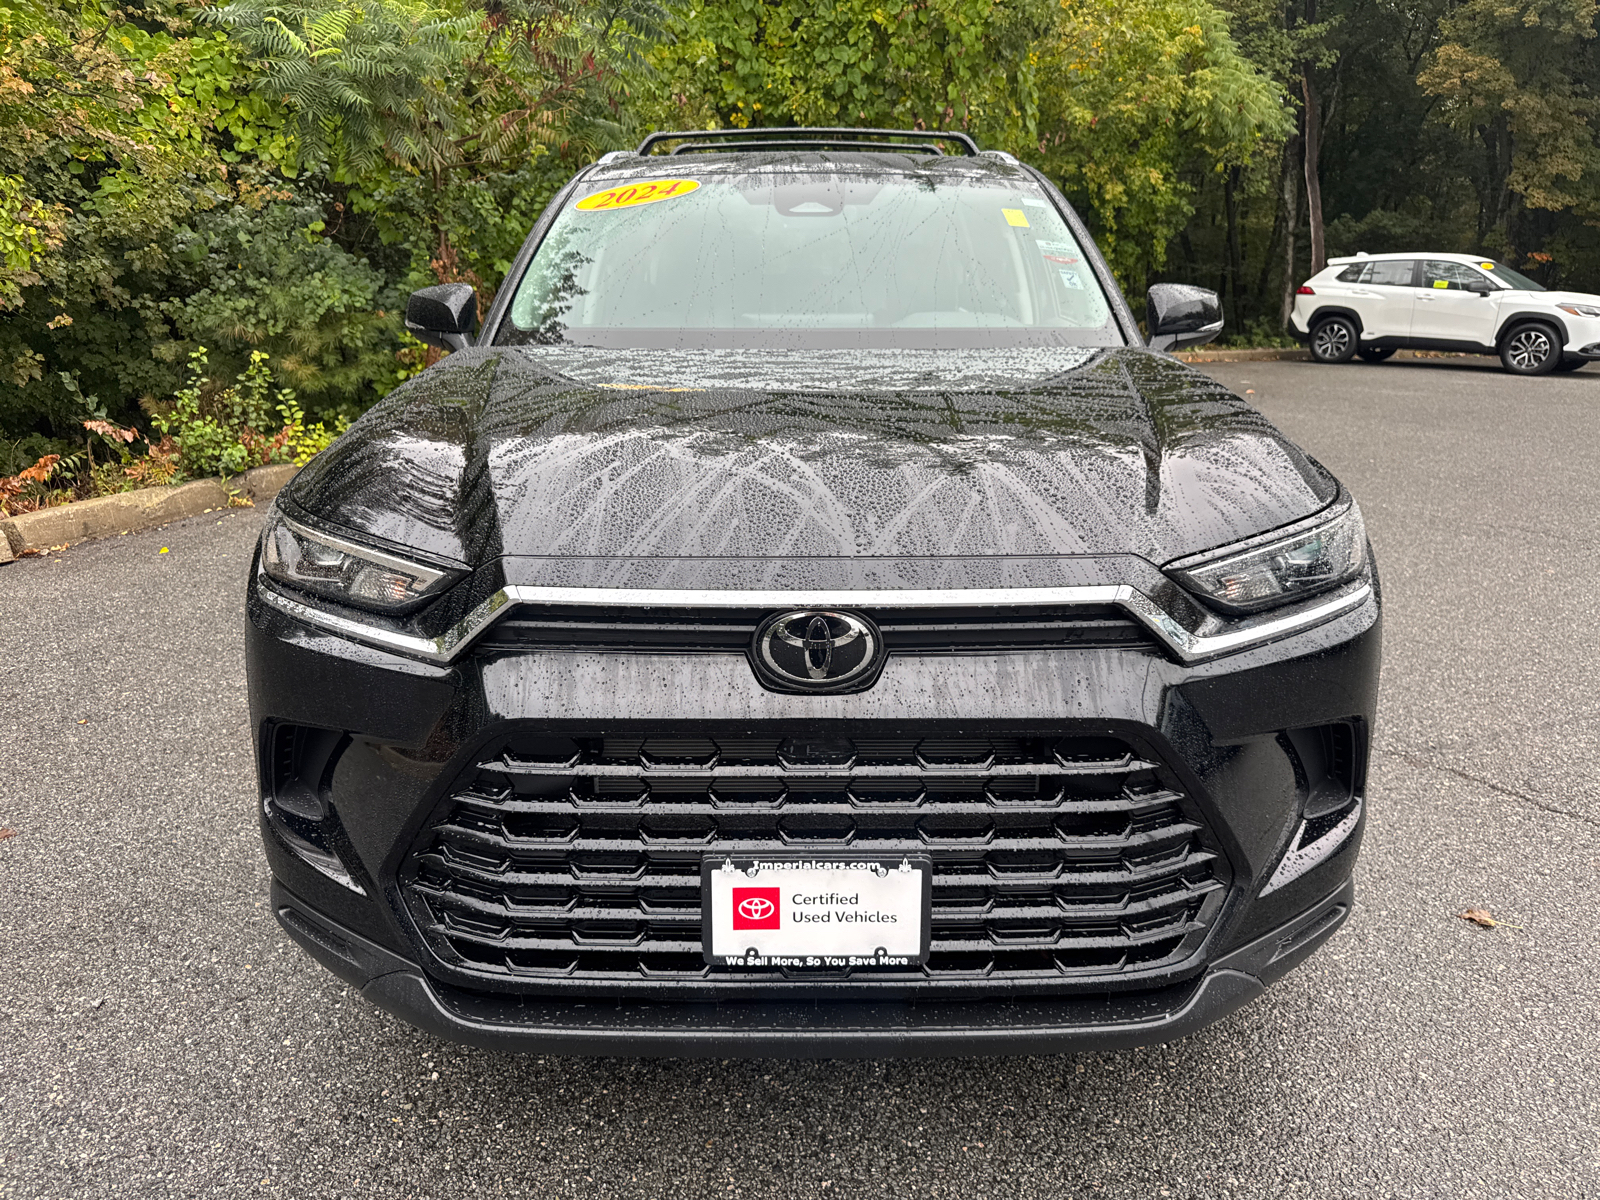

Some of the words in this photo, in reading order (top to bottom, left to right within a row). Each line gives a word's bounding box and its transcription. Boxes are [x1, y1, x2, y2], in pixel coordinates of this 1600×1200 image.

[594, 181, 682, 208] 2024
[753, 861, 881, 870] Imperialcars.com
[792, 893, 859, 905] Certified
[792, 911, 831, 923] Used
[835, 911, 898, 923] Vehicles
[726, 957, 744, 966] We
[747, 957, 768, 966] Sell
[771, 957, 804, 967] More,
[806, 957, 820, 966] So
[824, 957, 846, 966] You
[848, 957, 876, 966] Save
[880, 957, 908, 966] More
